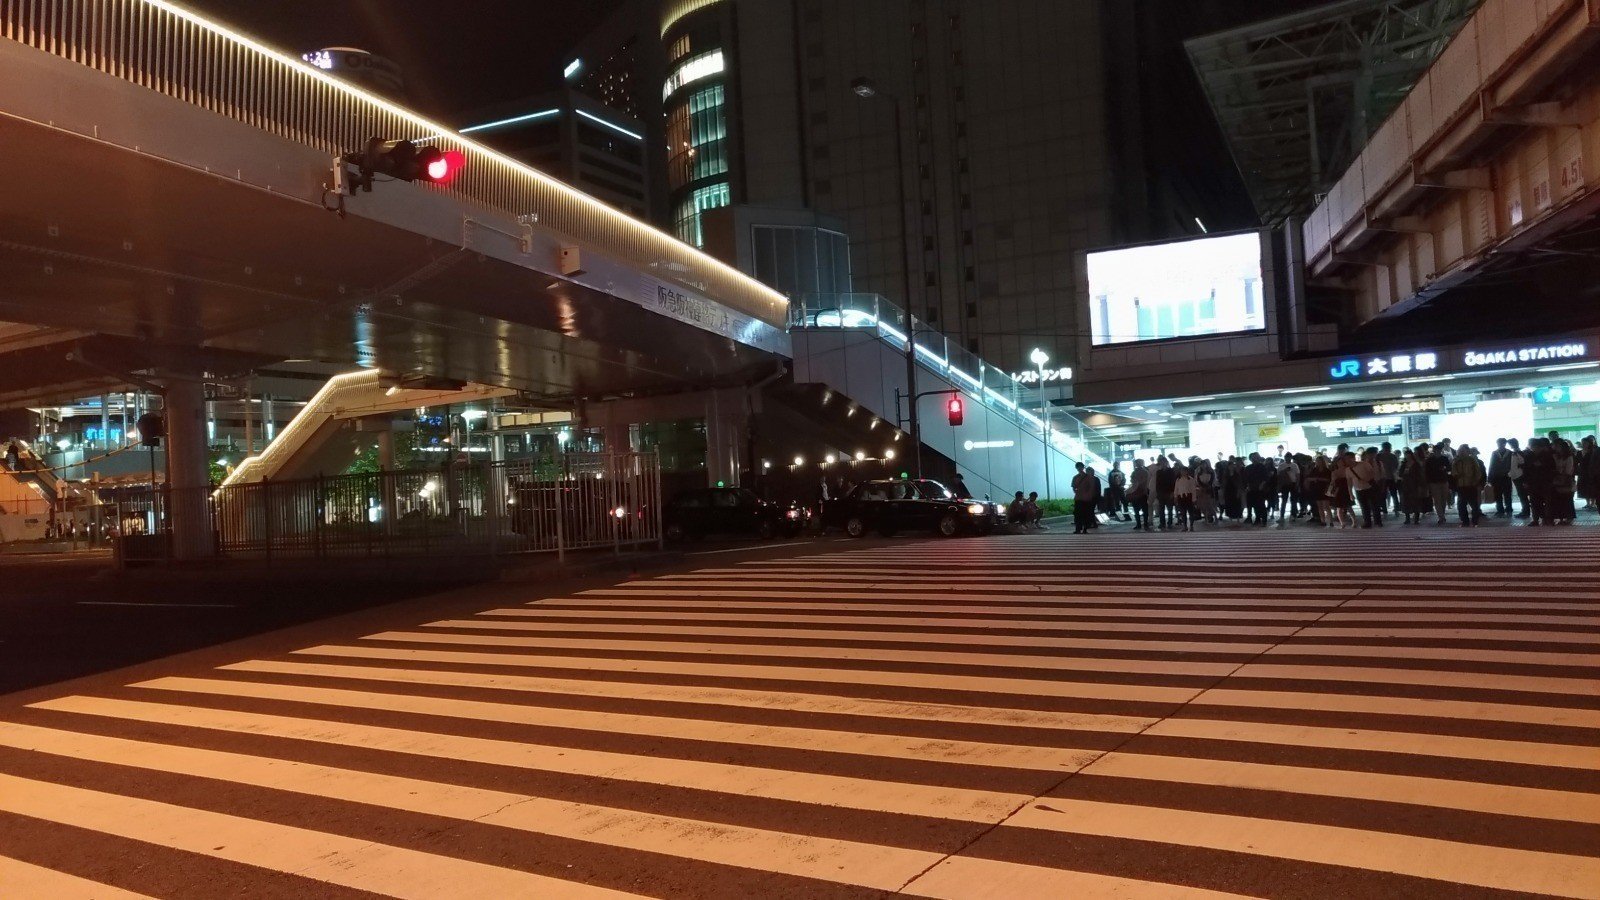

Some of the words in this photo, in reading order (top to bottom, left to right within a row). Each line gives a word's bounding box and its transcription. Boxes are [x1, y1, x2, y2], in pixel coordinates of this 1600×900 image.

[1518, 343, 1585, 362] STATION
[1330, 359, 1360, 378] JR
[1367, 352, 1437, 376] 大阪駅
